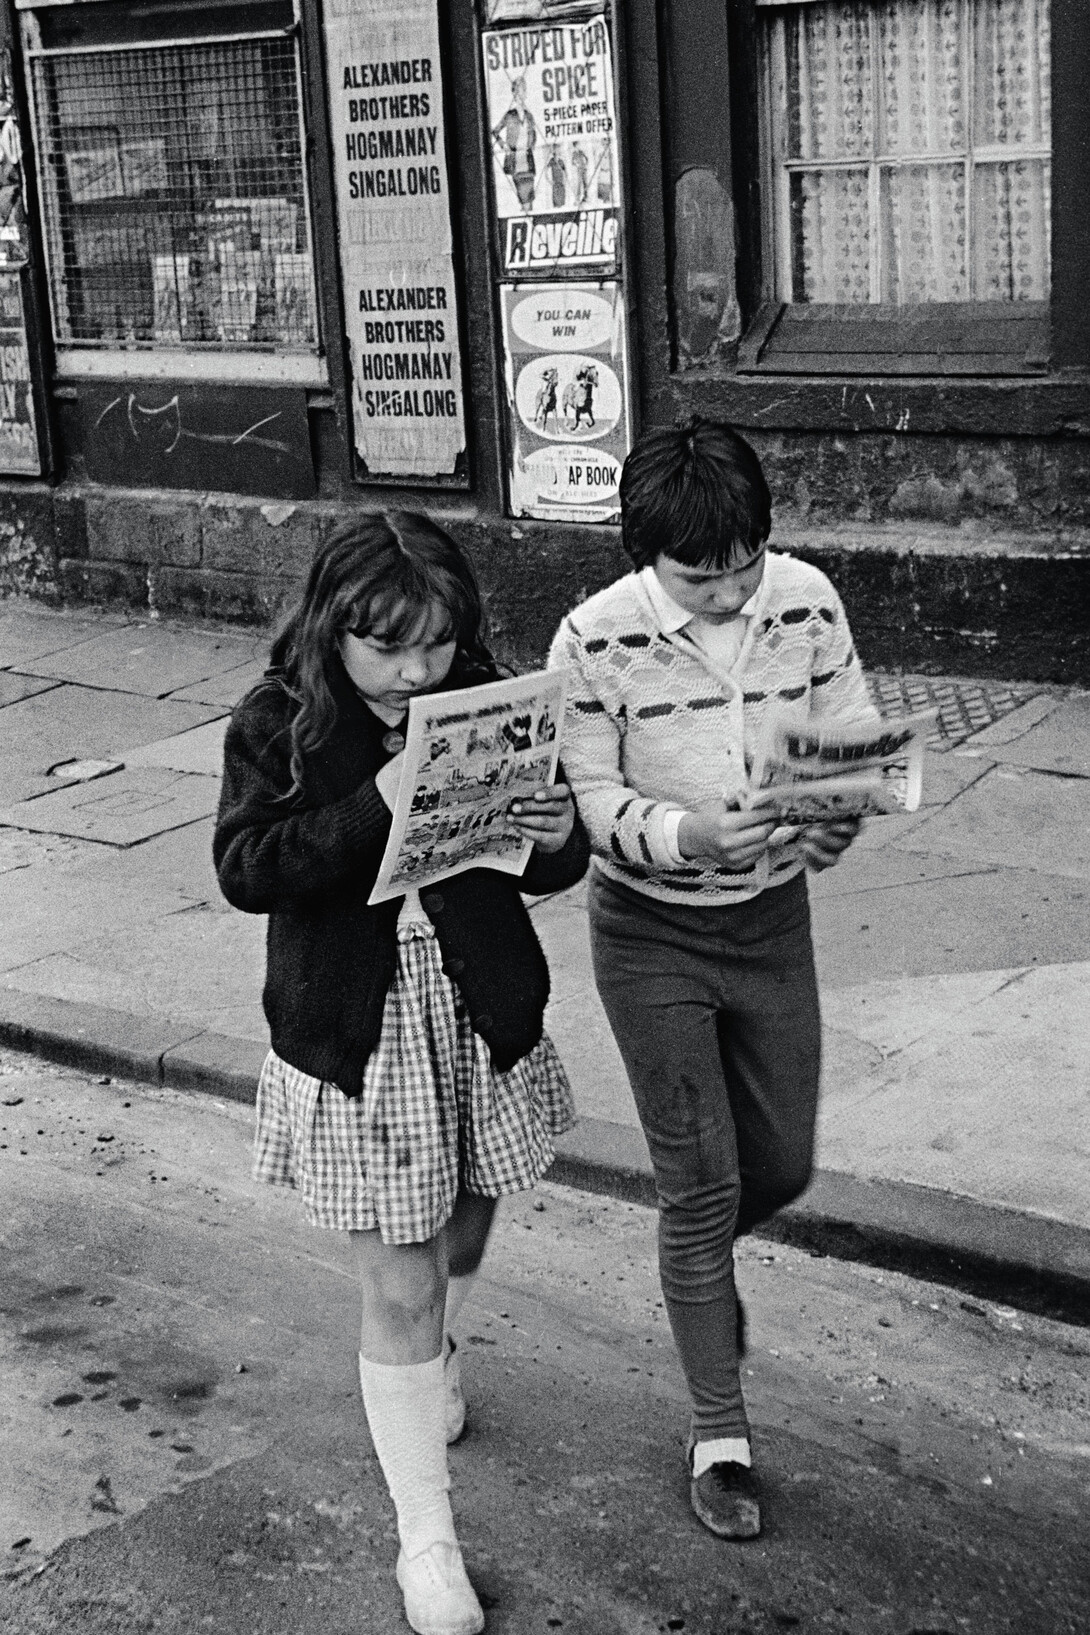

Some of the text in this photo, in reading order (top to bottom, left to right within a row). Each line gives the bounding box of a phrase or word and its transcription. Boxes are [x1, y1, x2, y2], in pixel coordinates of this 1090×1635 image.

[486, 20, 606, 71] STRIPED FOR
[343, 58, 433, 90] ALEXANDER
[541, 61, 599, 103] SPICE
[349, 92, 430, 123] BROTHERS
[543, 101, 608, 122] 5-PIECE PAPER
[545, 118, 613, 138] PATTERN OFFER
[345, 126, 437, 161] HOGMANAY
[348, 165, 441, 199] SINGALONG
[506, 209, 619, 268] Reveille
[359, 286, 447, 312] ALEXANDER
[536, 309, 591, 321] YOU CAN
[364, 319, 445, 344] BROTHERS
[552, 326, 576, 337] WIN
[361, 352, 452, 381] HOGMANAY
[365, 389, 457, 418] SINGALONG
[586, 466, 618, 486] BOOK
